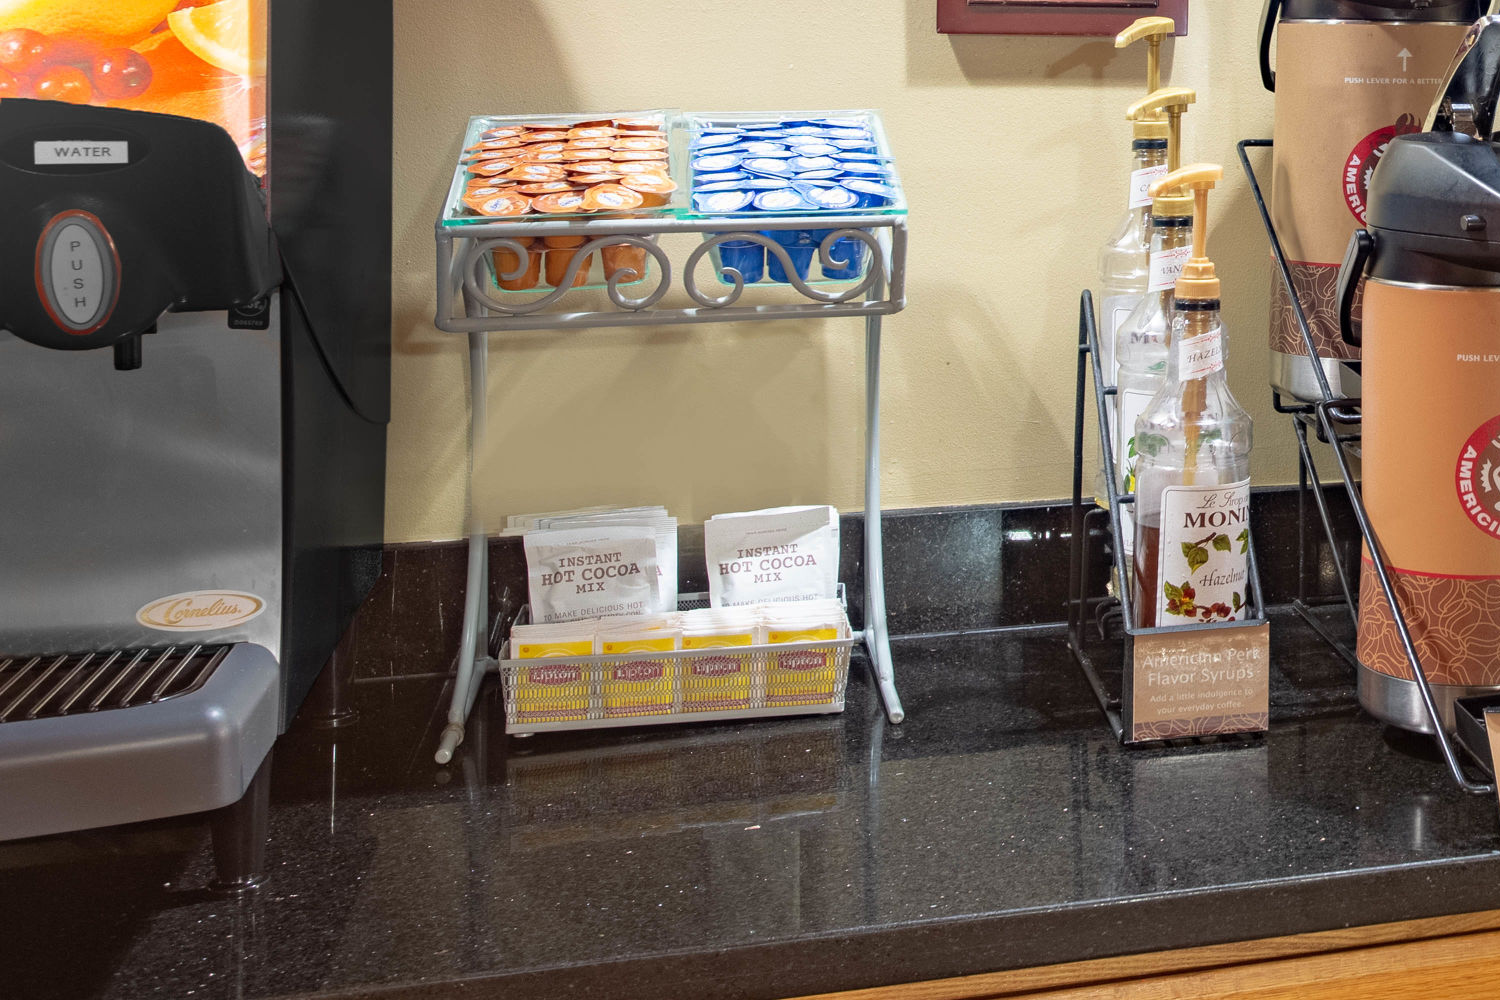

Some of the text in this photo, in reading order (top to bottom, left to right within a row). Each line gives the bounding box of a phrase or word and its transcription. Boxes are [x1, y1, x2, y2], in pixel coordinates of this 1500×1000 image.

[54, 146, 112, 158] WATER
[1345, 153, 1367, 222] AMERI
[69, 240, 87, 308] PUSH
[1456, 353, 1480, 362] PUSH
[736, 543, 798, 559] INSTANT
[558, 552, 622, 568] INSTANT
[718, 554, 817, 576] HOT COCOA
[541, 570, 576, 587] HOT
[581, 562, 641, 581] COCOA
[753, 572, 783, 583] MIX
[575, 582, 606, 594] MIX
[163, 597, 241, 625] Cornelius
[554, 609, 578, 619] MAKE
[580, 603, 625, 616] DELICIOUS
[627, 601, 644, 610] HOT
[1148, 667, 1255, 686] Flavor Syrups
[1151, 694, 1167, 703] Add
[1176, 691, 1195, 700] little
[1197, 688, 1243, 700] indulgence
[1245, 688, 1253, 696] to
[1156, 706, 1176, 715] your
[1178, 701, 1215, 713] everyday
